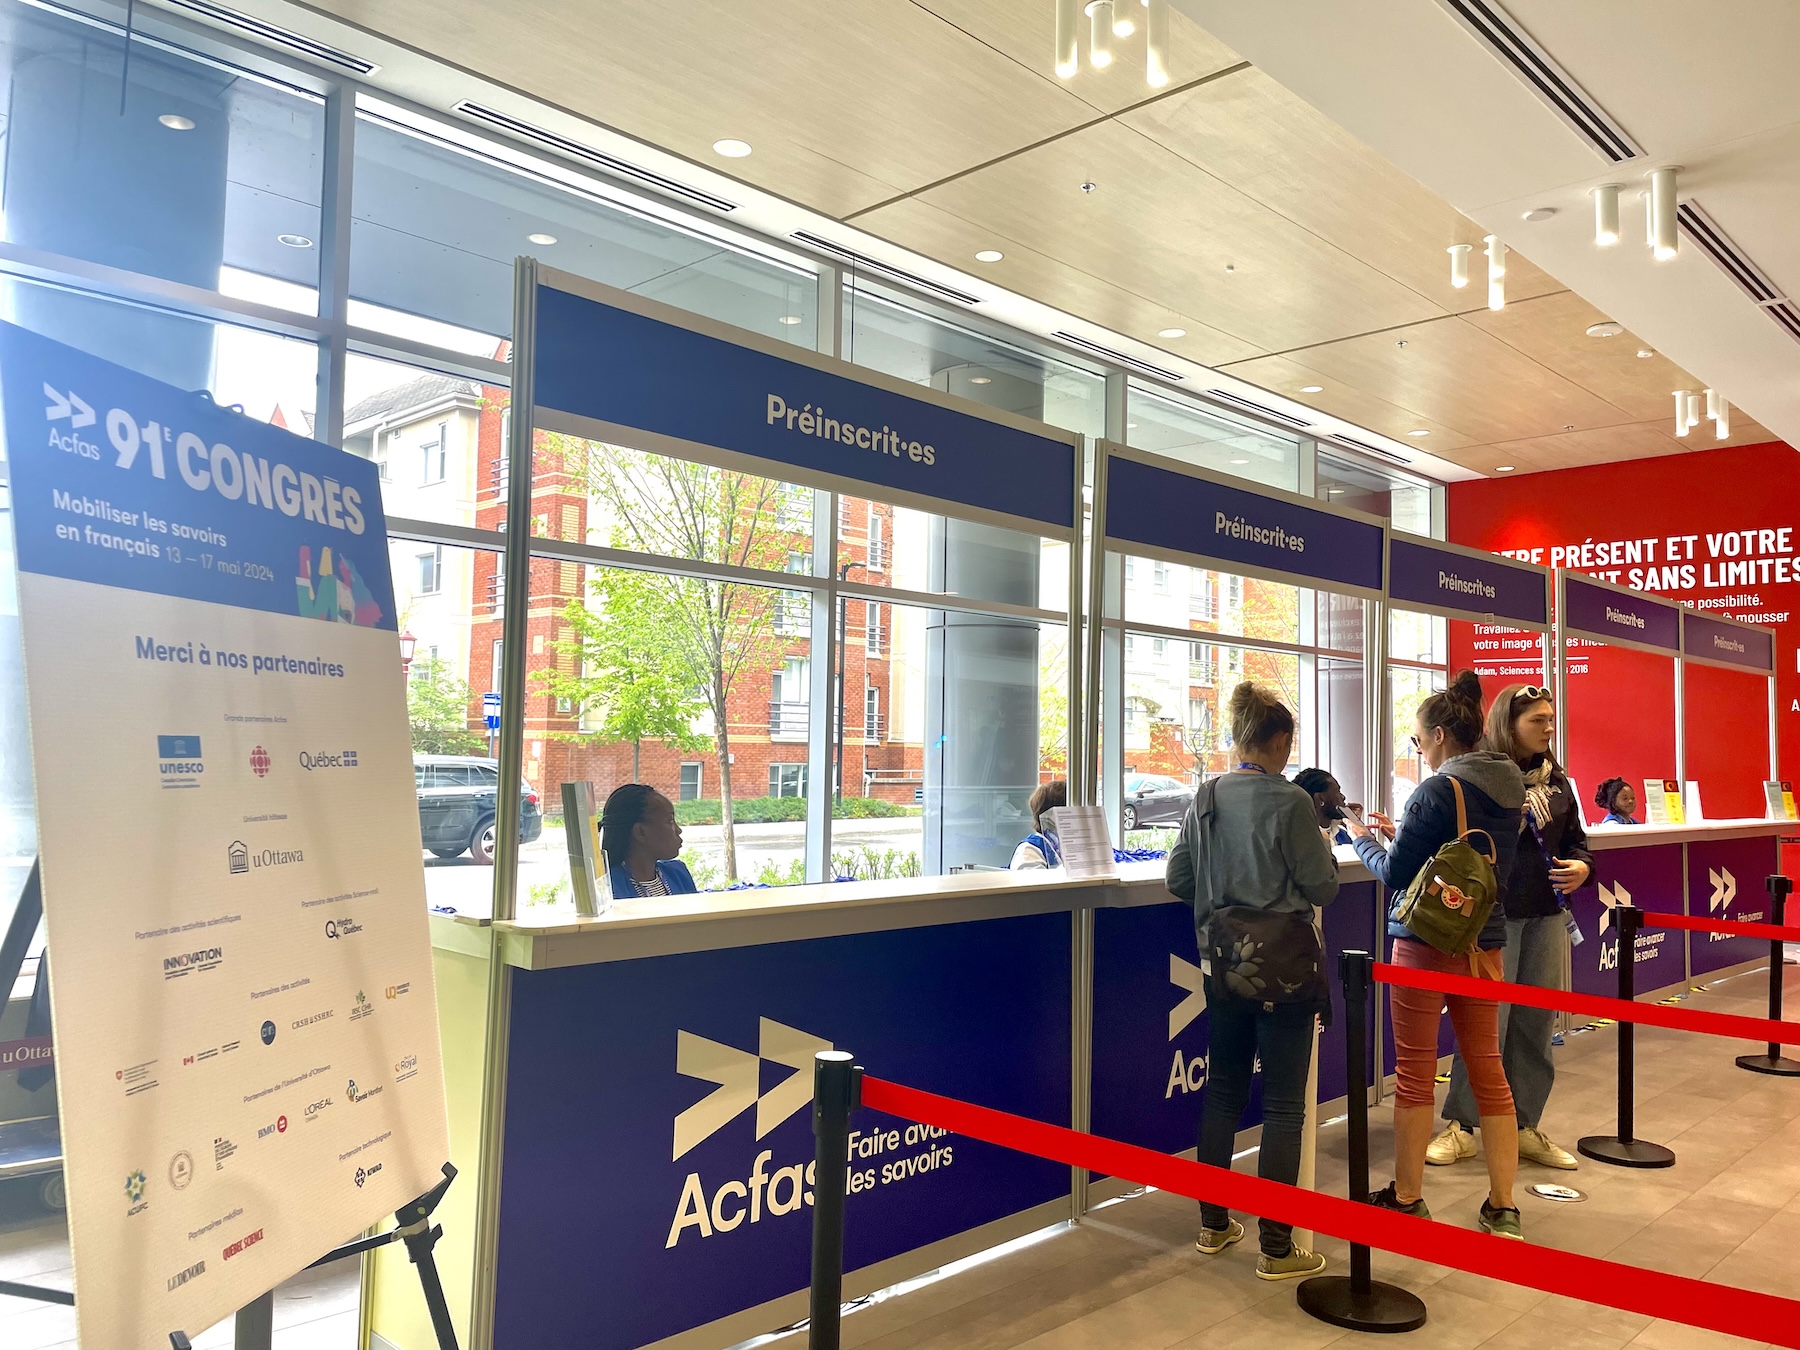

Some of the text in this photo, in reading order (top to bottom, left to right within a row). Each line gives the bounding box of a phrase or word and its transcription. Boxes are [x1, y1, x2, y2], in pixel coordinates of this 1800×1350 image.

[48, 426, 101, 461] Acfas
[52, 488, 228, 547] Mobiliser les savoirs
[55, 523, 80, 542] en
[84, 524, 160, 558] français
[165, 545, 182, 563] 13
[200, 553, 214, 570] 17
[217, 560, 241, 576] mai
[243, 562, 275, 582] 2024
[1550, 537, 1659, 570] PRÉSENT
[1666, 535, 1699, 561] ET
[1705, 527, 1794, 558] VOTRE
[1628, 564, 1697, 591] SANS
[1697, 594, 1764, 610] possibilité.
[1736, 612, 1790, 624] mousser
[1473, 640, 1500, 650] votre
[1501, 638, 1533, 651] image
[135, 635, 345, 678] Merci à nos partenaires
[1499, 666, 1535, 676] Sciences
[1569, 664, 1589, 674] 2016
[159, 762, 204, 774] unesco
[299, 750, 343, 771] Québec
[252, 848, 305, 868] uOttawa
[336, 917, 353, 928] Hydro
[343, 924, 363, 935] Québec
[134, 927, 169, 940] Partenaire
[169, 926, 181, 934] des
[163, 946, 223, 971] INNOVATION
[250, 986, 280, 1000] Partenaires
[280, 983, 290, 992] des
[243, 1087, 274, 1104] Partenaires
[258, 1123, 276, 1139] BMO
[847, 1126, 900, 1162] Faire
[845, 1143, 953, 1195] les savoirs
[188, 1219, 222, 1240] Partenaires
